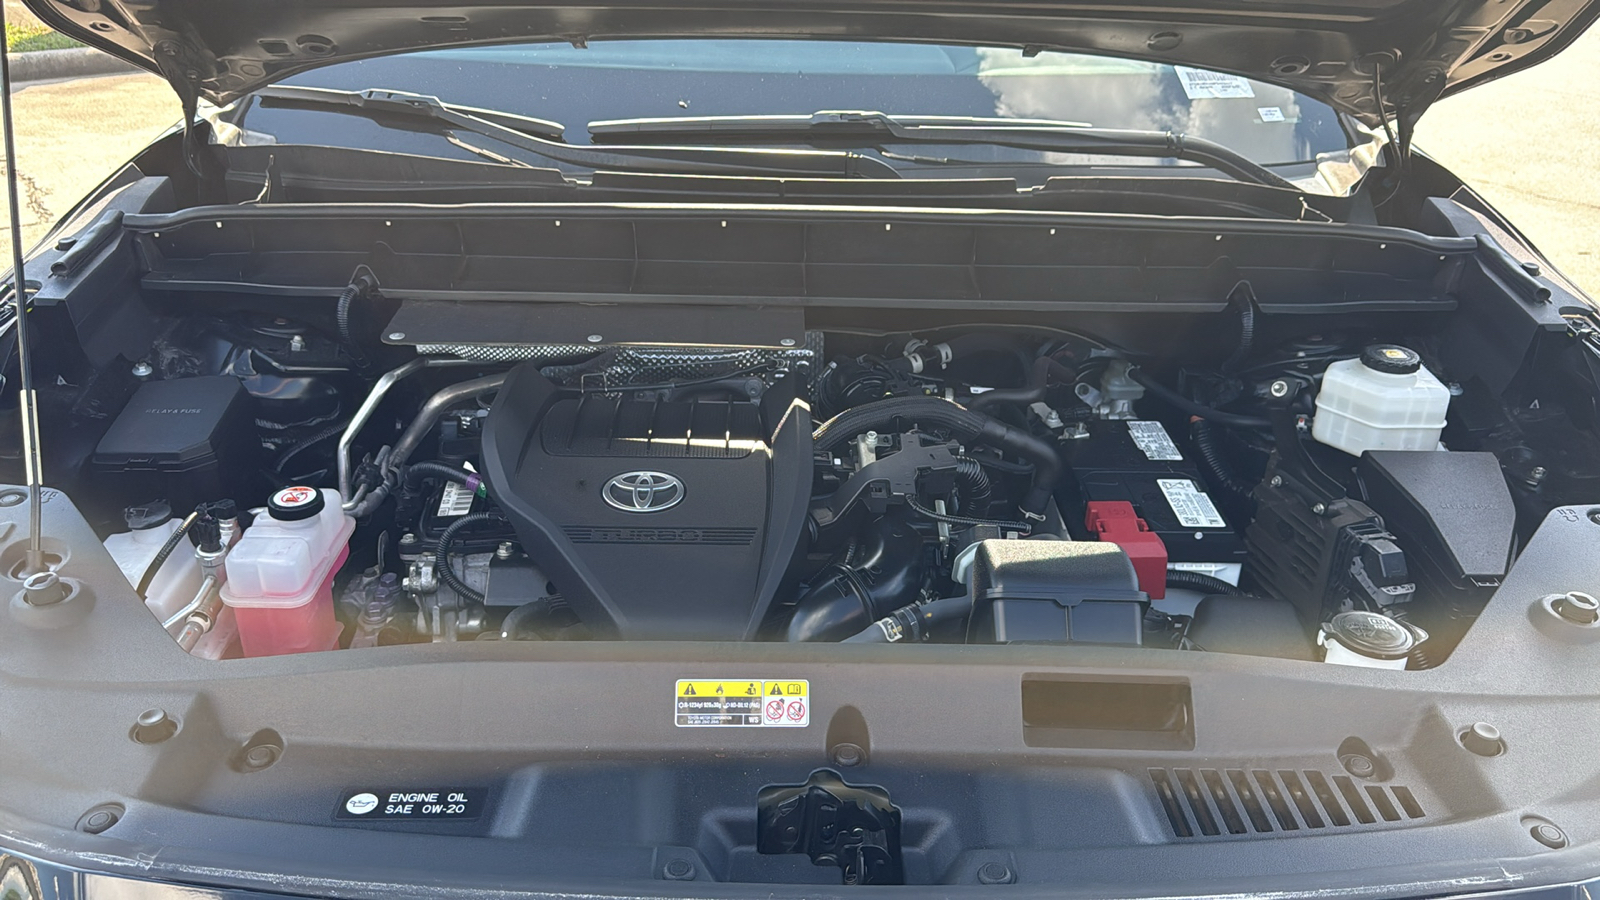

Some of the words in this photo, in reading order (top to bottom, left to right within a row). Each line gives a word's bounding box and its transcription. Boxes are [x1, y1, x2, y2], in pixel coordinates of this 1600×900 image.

[594, 529, 700, 541] TURBO
[388, 793, 439, 803] ENGINE
[447, 793, 468, 802] OIL
[385, 804, 414, 814] SAE
[422, 804, 465, 814] 0W-20
